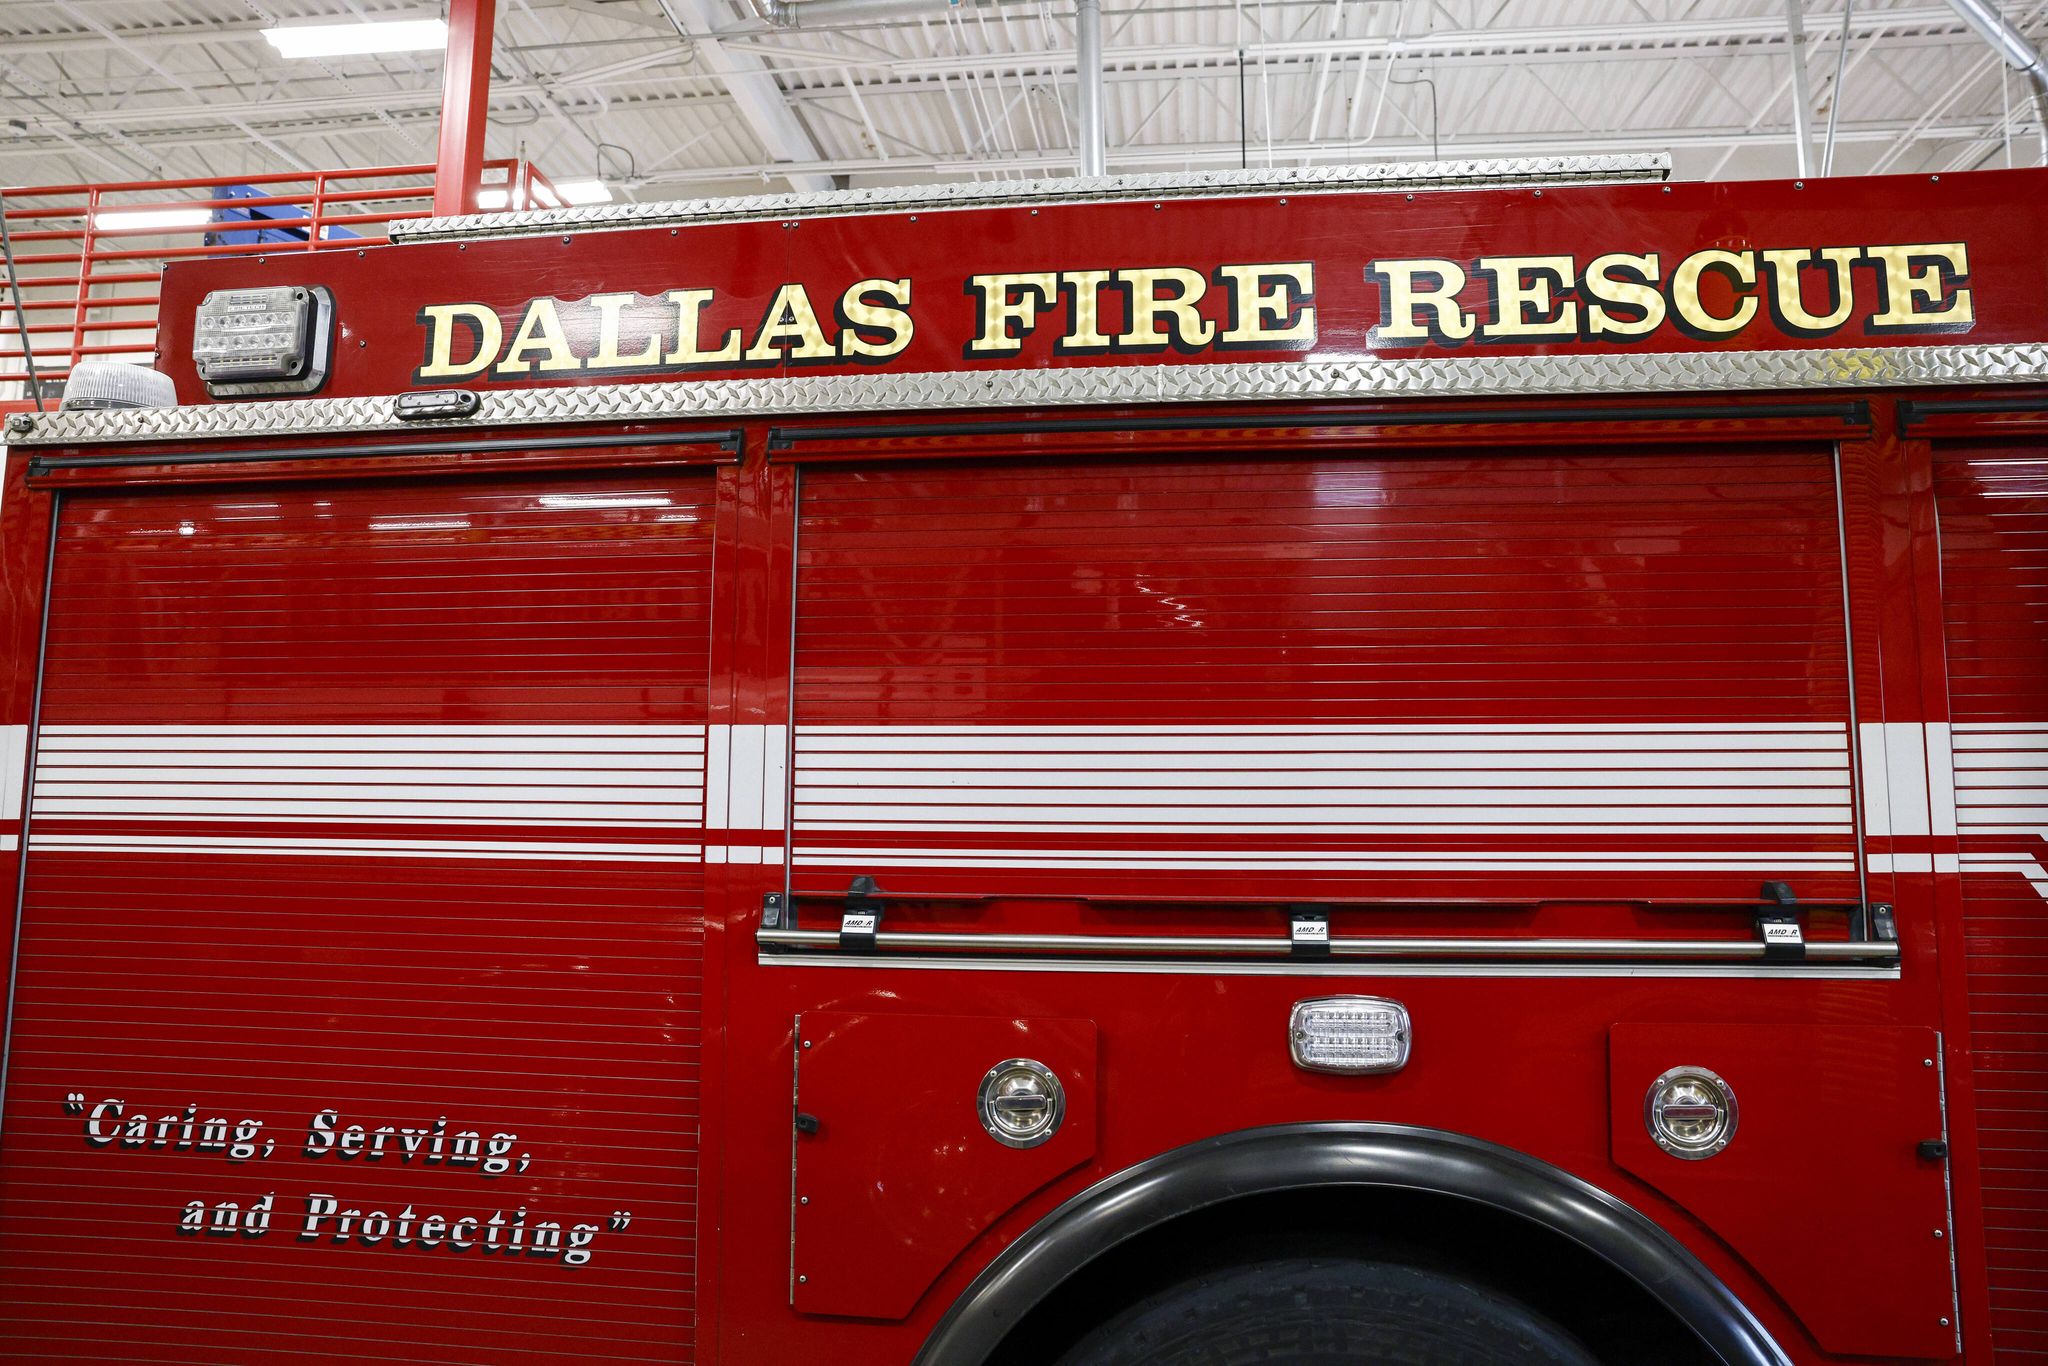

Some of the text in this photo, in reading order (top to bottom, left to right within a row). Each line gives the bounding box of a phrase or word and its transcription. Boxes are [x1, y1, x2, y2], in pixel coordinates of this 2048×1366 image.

[414, 241, 1975, 381] DALLAS FIRE RESCUE
[306, 1108, 532, 1174] Serving,
[180, 1191, 275, 1235] and
